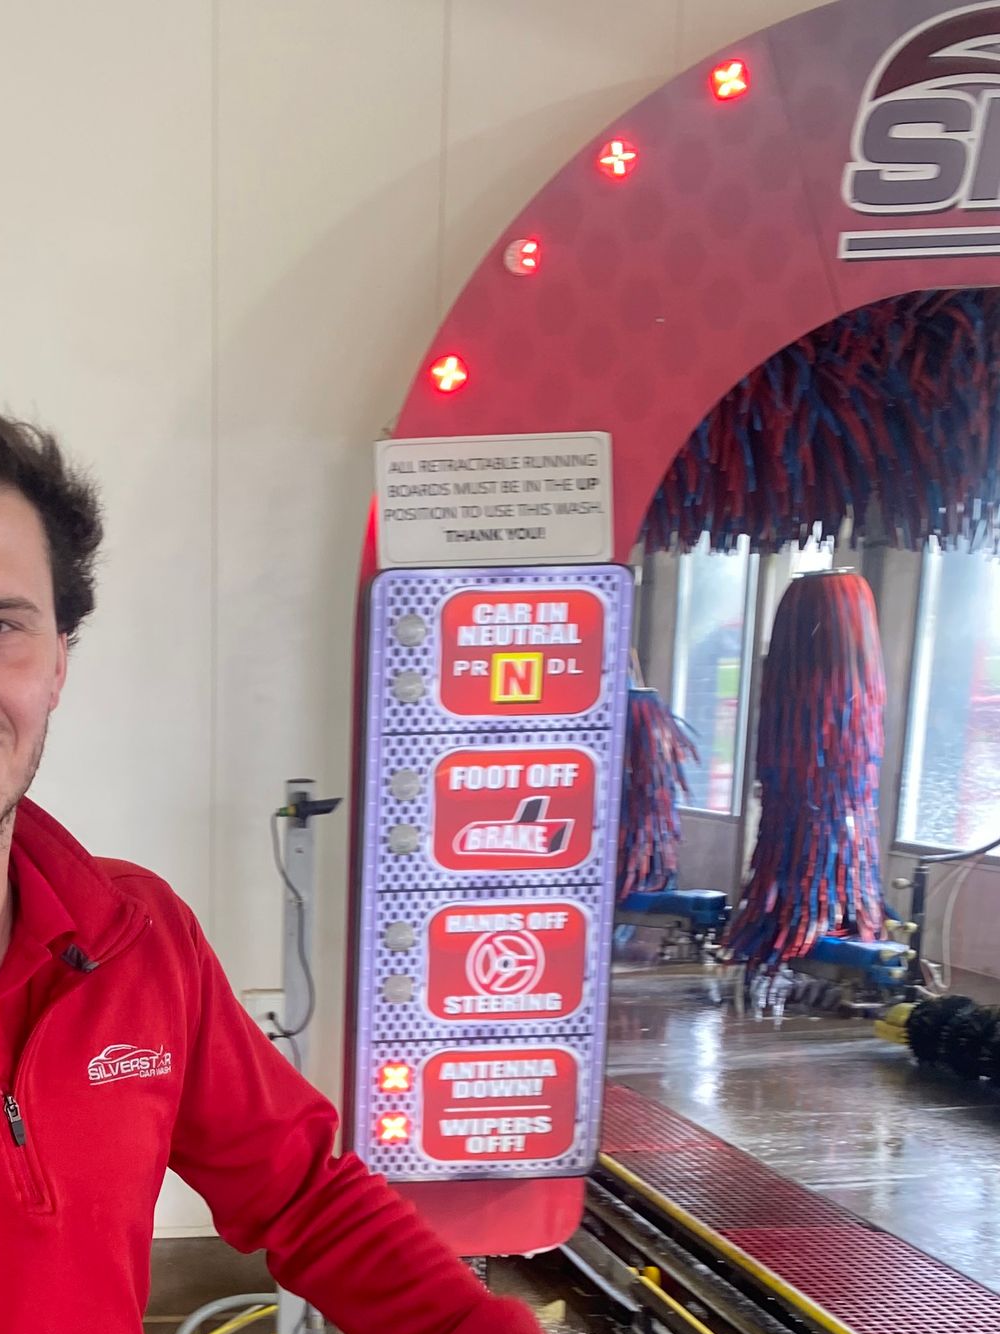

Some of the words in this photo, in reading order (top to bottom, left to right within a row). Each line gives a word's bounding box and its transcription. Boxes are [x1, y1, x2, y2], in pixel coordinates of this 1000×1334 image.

[388, 460, 416, 474] ALL
[418, 457, 520, 473] RETRACTABLE
[522, 453, 598, 469] RUNNING
[387, 483, 451, 498] BOARDS
[453, 481, 497, 496] MUST
[501, 479, 520, 494] BE
[523, 479, 541, 493] IN
[544, 478, 574, 492] THE
[576, 477, 600, 491] UP
[384, 506, 459, 521] POSITION
[460, 505, 482, 519] TO
[484, 503, 516, 517] USE
[517, 502, 552, 516] THIS
[443, 529, 504, 543] THANK
[505, 526, 546, 541] YOU!
[472, 602, 532, 624] CAR
[538, 602, 568, 623] IN
[457, 623, 582, 646] NEUTRAL
[450, 764, 523, 790] FOOT
[527, 763, 579, 788] OFF
[464, 825, 548, 852] BRAKE
[445, 913, 524, 933] HANDS
[527, 911, 569, 930] OFF
[443, 992, 562, 1015] STEERING
[140, 1069, 156, 1078] CAR
[156, 1065, 172, 1076] WASH
[439, 1058, 557, 1080] ANTENNA
[452, 1078, 543, 1099] DOWN!
[439, 1115, 552, 1137] WIPERS
[465, 1134, 526, 1154] OFF!
